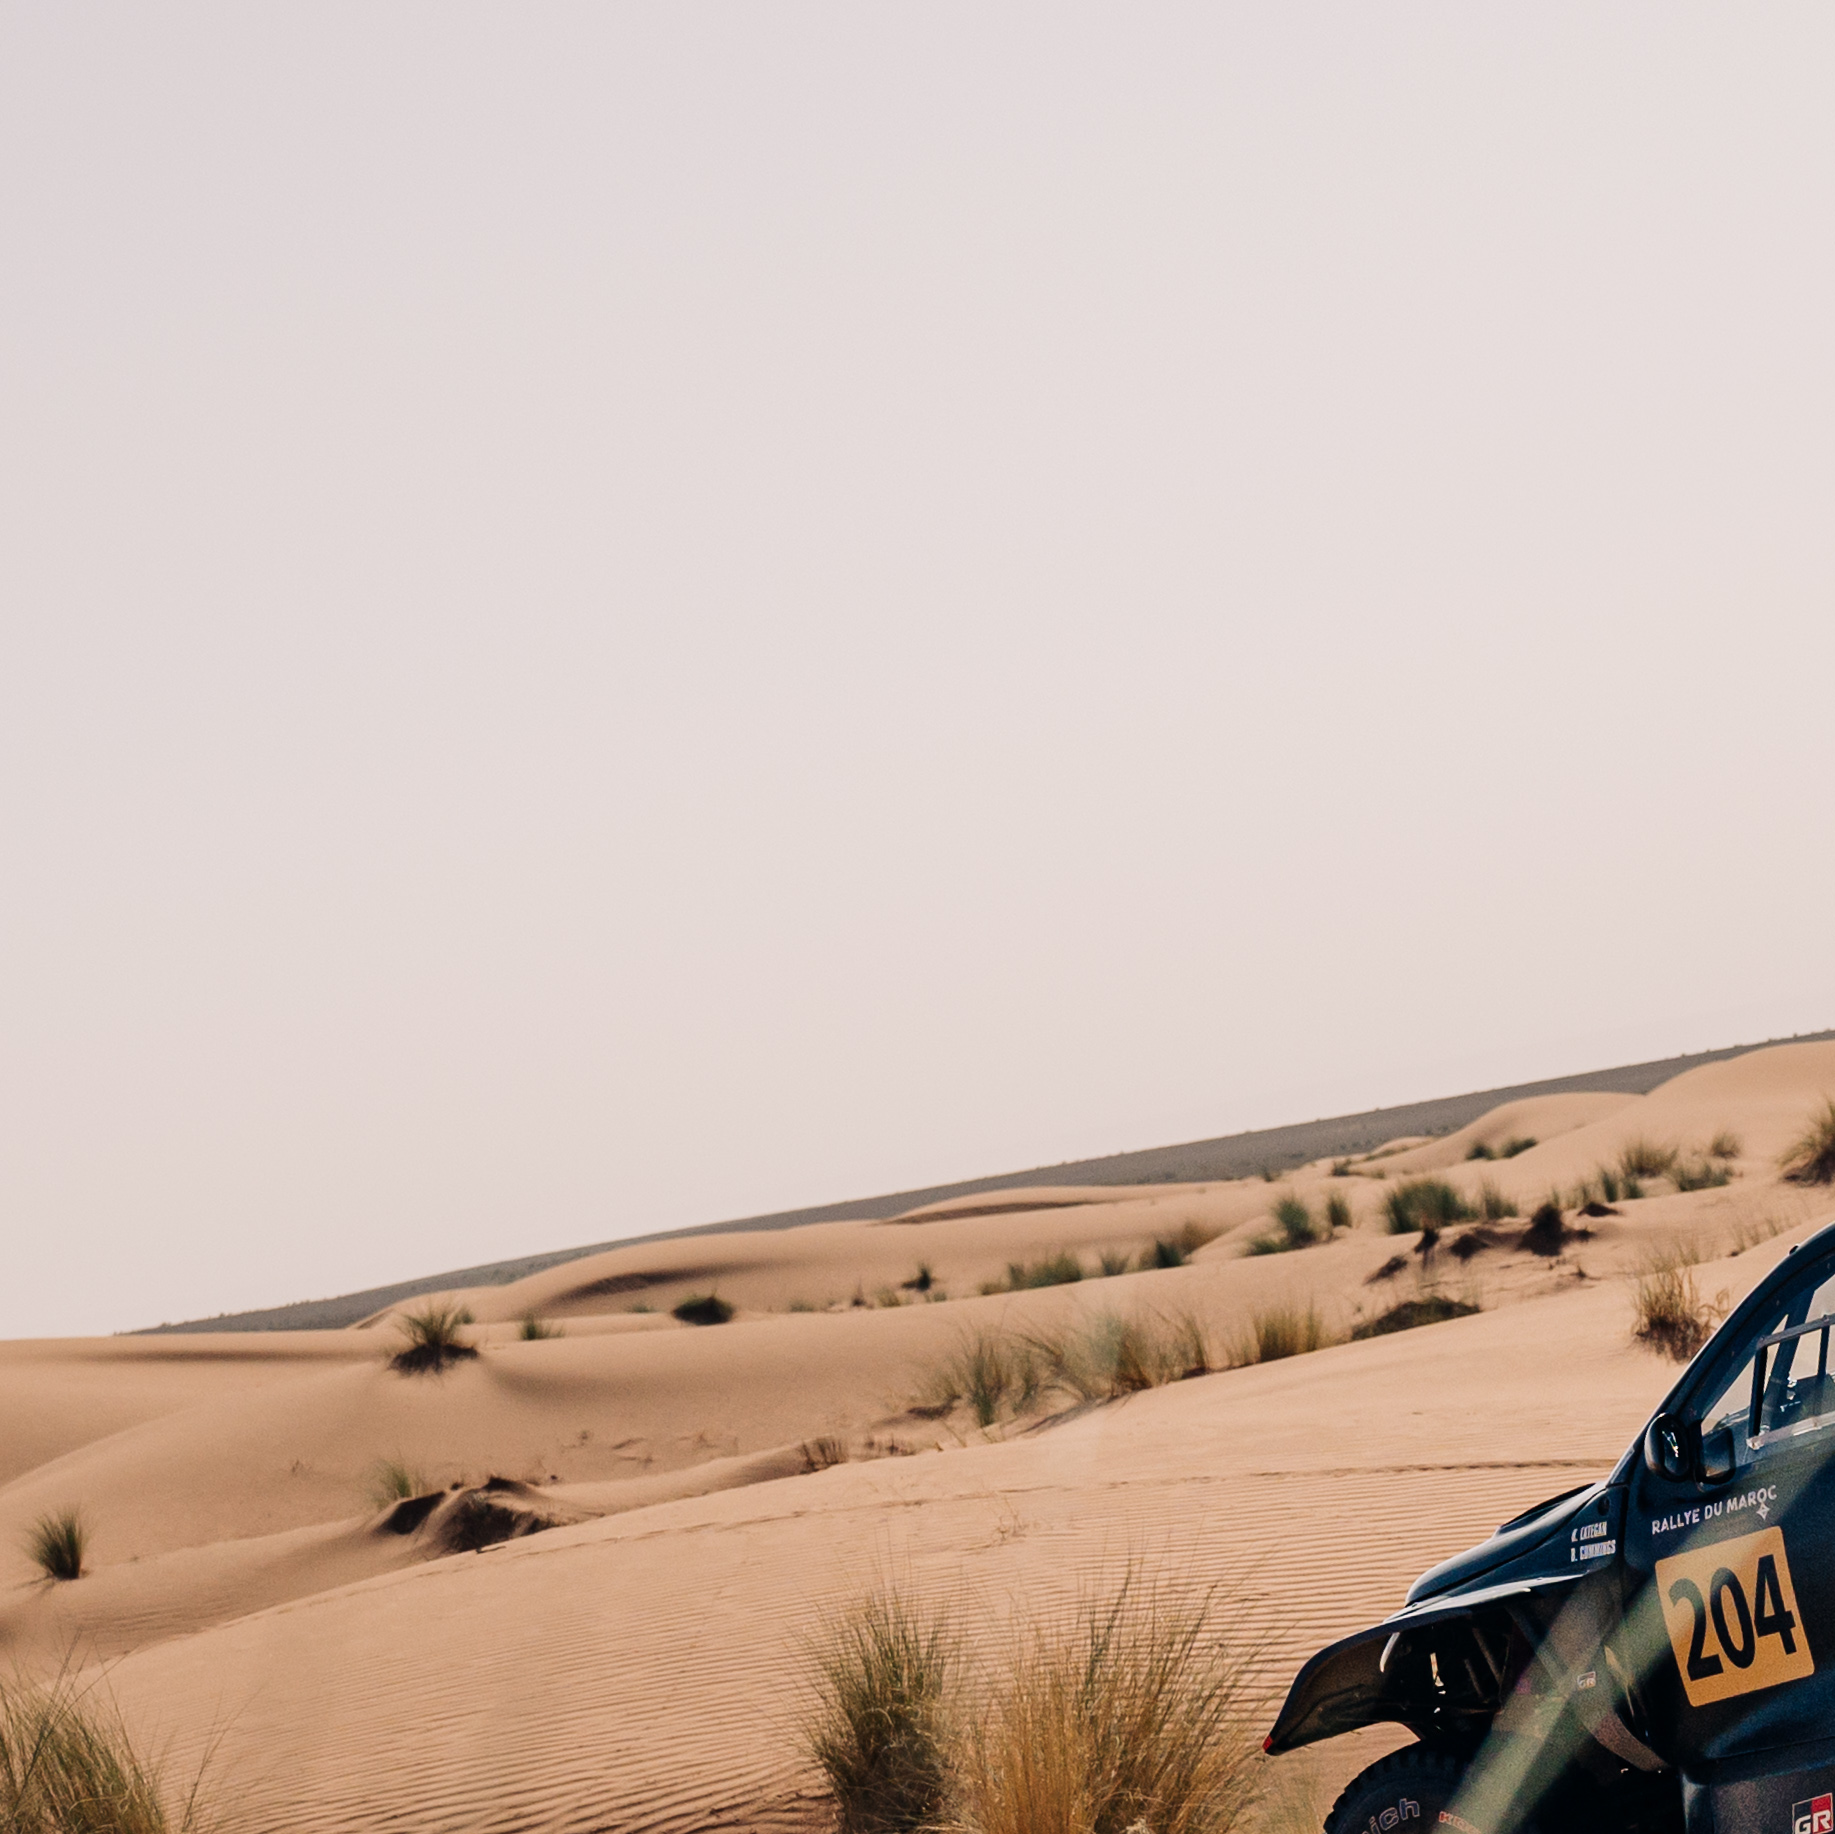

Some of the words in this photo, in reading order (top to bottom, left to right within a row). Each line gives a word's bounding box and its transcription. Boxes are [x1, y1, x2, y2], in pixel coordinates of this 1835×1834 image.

[1652, 1508, 1700, 1535] RALLYE
[1704, 1501, 1723, 1520] DU
[1726, 1484, 1778, 1514] MAROC
[1668, 1553, 1798, 1682] 204
